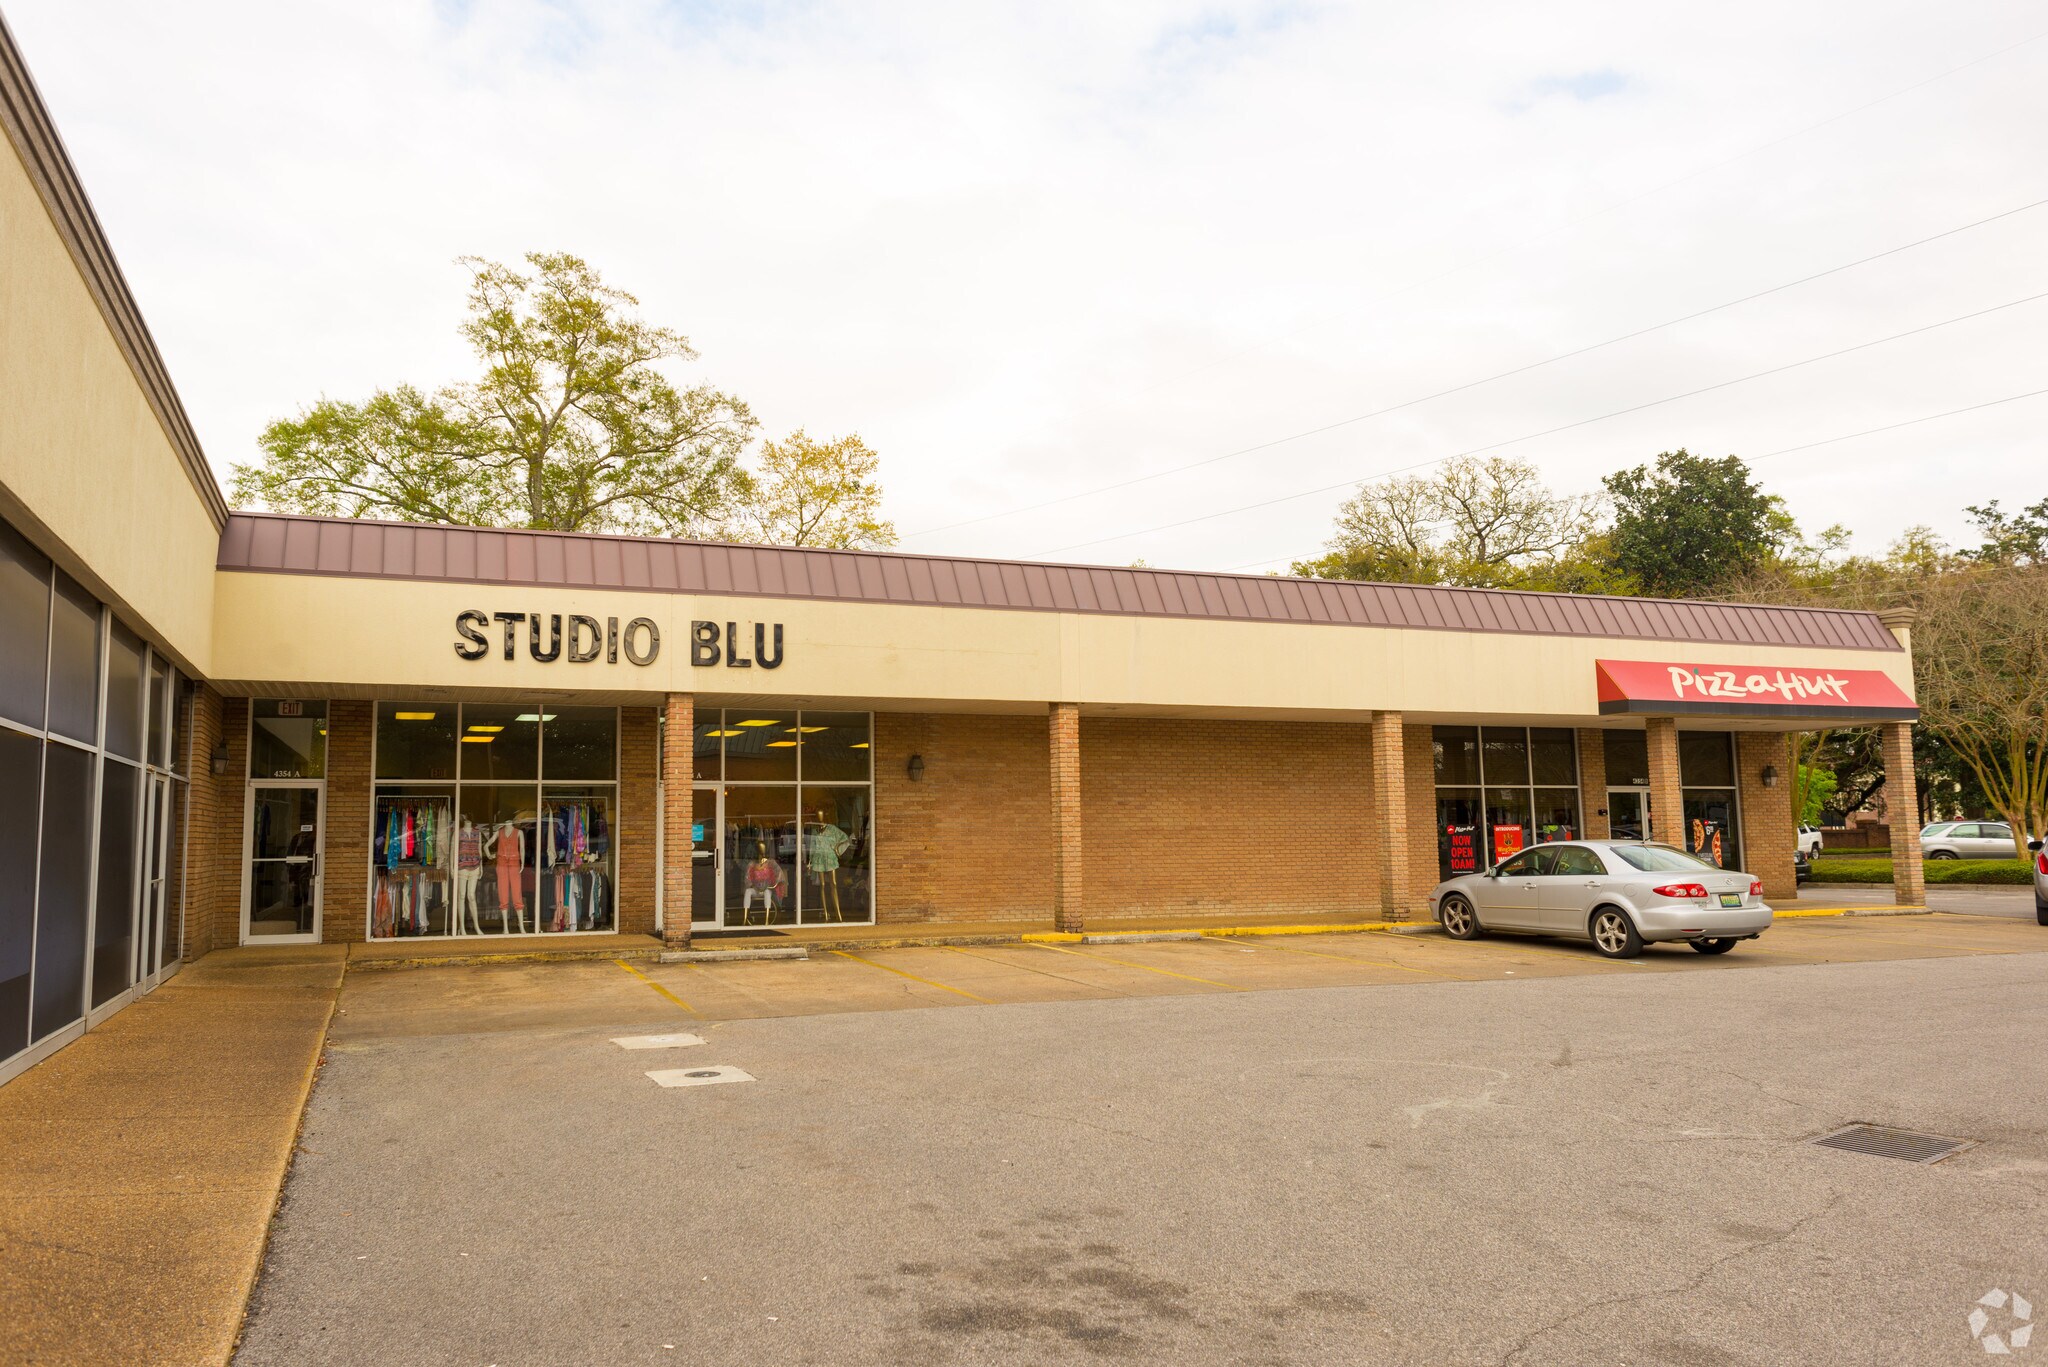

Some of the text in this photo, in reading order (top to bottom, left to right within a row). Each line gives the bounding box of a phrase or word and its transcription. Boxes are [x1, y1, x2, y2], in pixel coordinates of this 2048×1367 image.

[454, 609, 783, 669] STUDIO BLU
[1667, 666, 1849, 702] Pizza Hut
[282, 702, 300, 714] EXIT
[1452, 835, 1471, 846] NOW
[1451, 847, 1473, 858] OPEN
[1451, 858, 1475, 869] 10AM!
